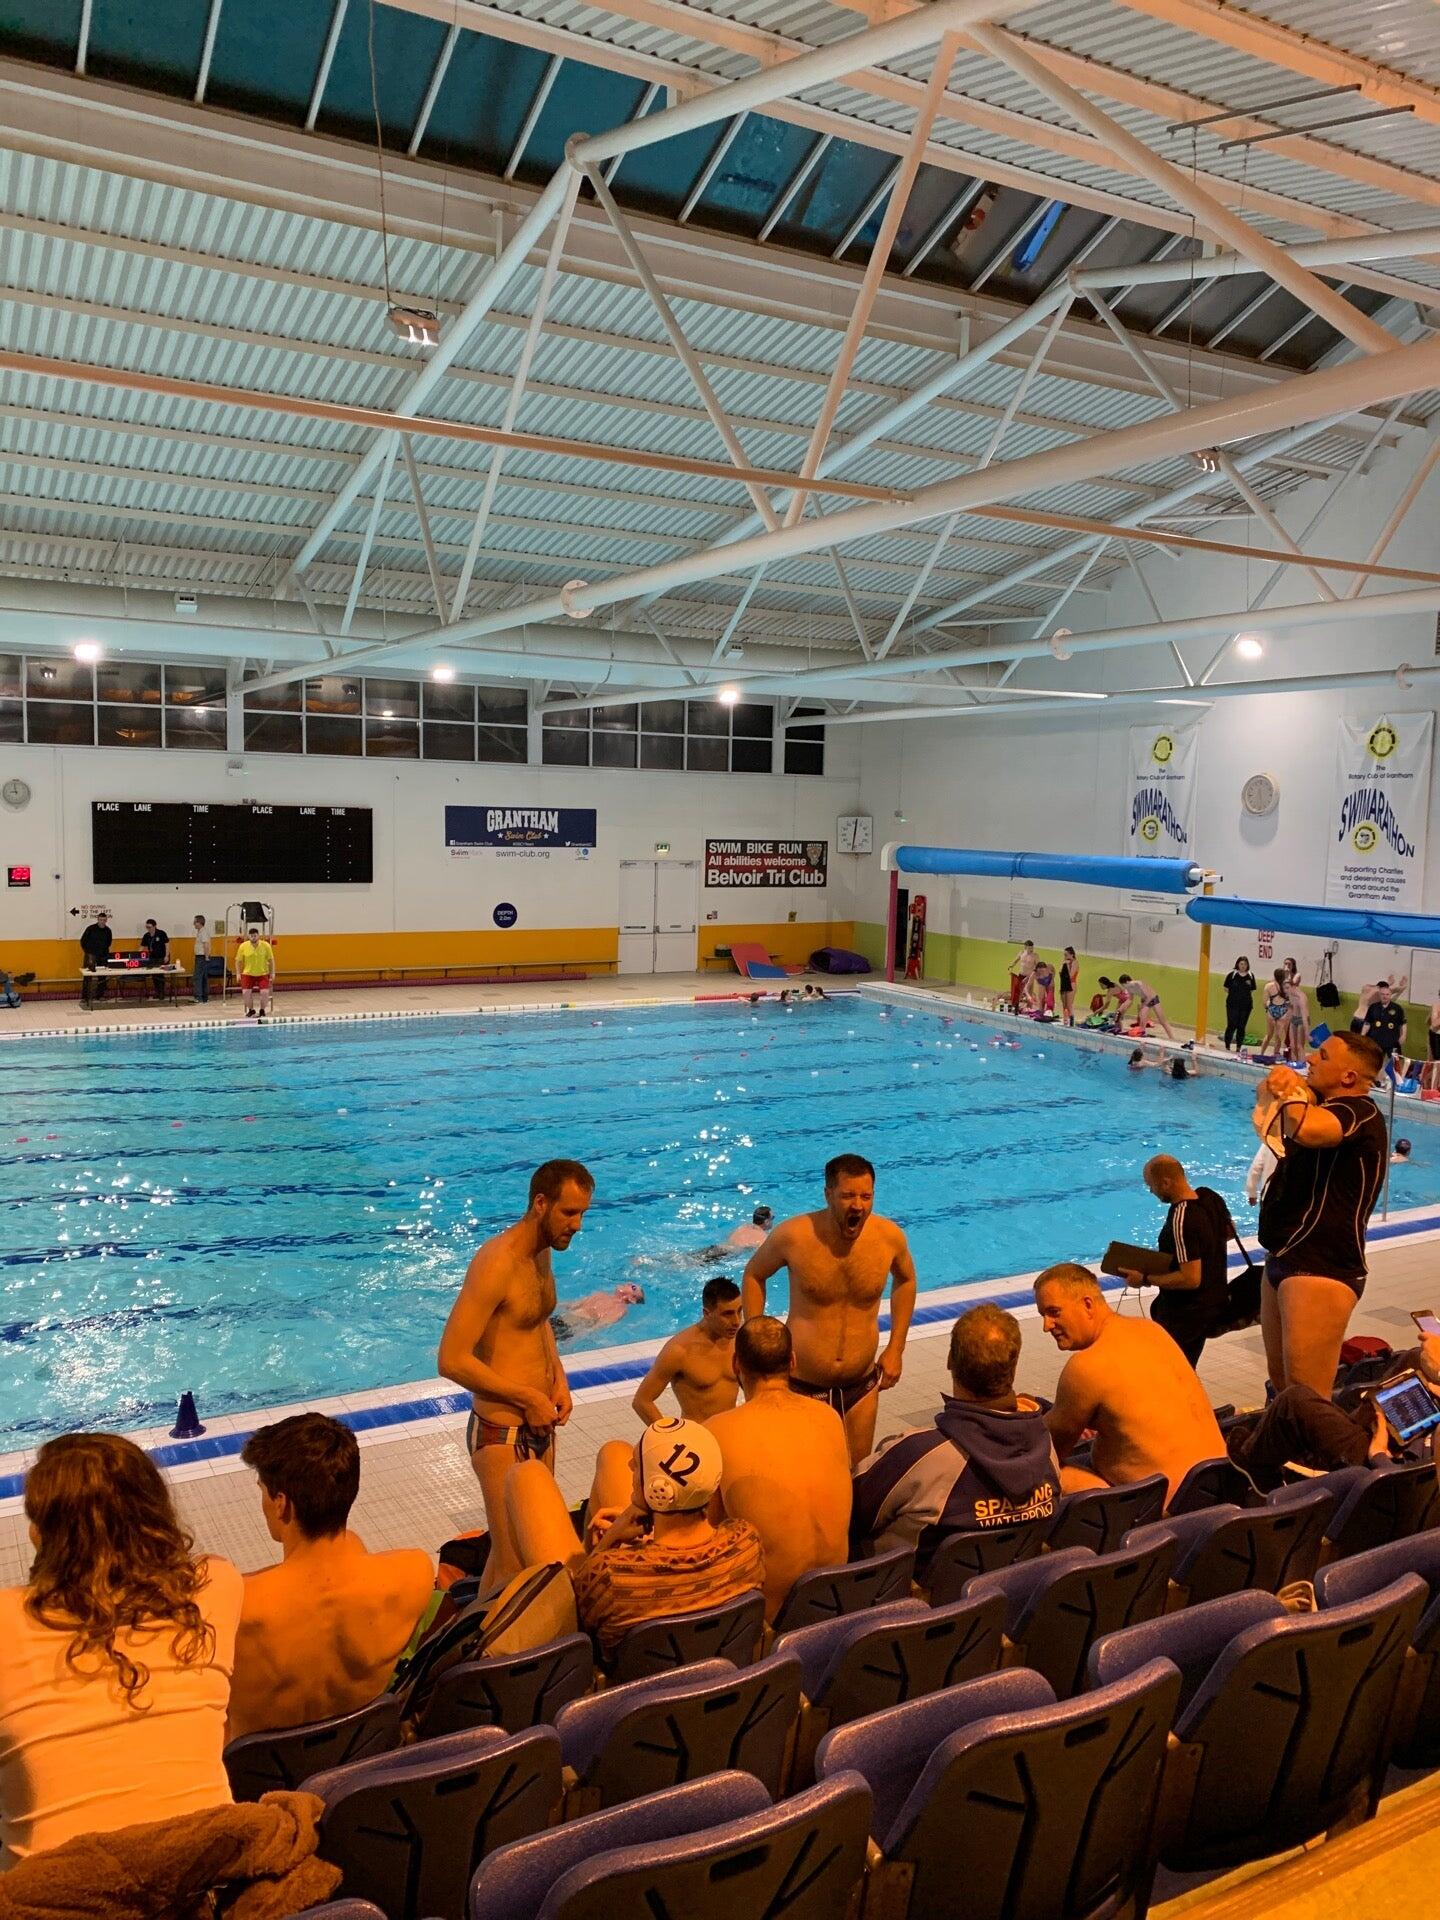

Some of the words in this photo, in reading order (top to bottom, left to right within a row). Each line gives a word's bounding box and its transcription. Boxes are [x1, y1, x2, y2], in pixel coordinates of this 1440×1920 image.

[97, 803, 120, 811] PLACE
[133, 803, 152, 812] LANE
[193, 805, 209, 813] TIME
[252, 806, 273, 814] PLACE
[300, 807, 316, 815] LANE
[331, 808, 346, 816] TIME
[1131, 788, 1187, 844] SWIMARATHON
[486, 809, 559, 834] GRANTHAM
[1339, 788, 1415, 858] SWIMARATHON
[504, 830, 524, 841] Swim
[526, 830, 543, 841] Club
[495, 849, 550, 859] swim-club.org
[708, 842, 741, 854] SWIM
[746, 842, 773, 854] BIKE
[778, 843, 802, 854] RUN
[708, 855, 722, 866] All
[723, 855, 762, 866] abilities
[764, 857, 807, 867] welcome
[1344, 865, 1377, 875] Supporting
[1378, 867, 1404, 875] Charities
[708, 869, 763, 885] Belvoir
[766, 869, 786, 885] Tri
[789, 869, 824, 885] Club
[1353, 875, 1384, 884] deserving
[1368, 884, 1389, 892] around
[1348, 891, 1380, 900] Grantham
[1258, 929, 1274, 942] DEEP
[1258, 945, 1273, 959] END
[658, 1443, 700, 1487] 12
[974, 1482, 1053, 1518] SPAING
